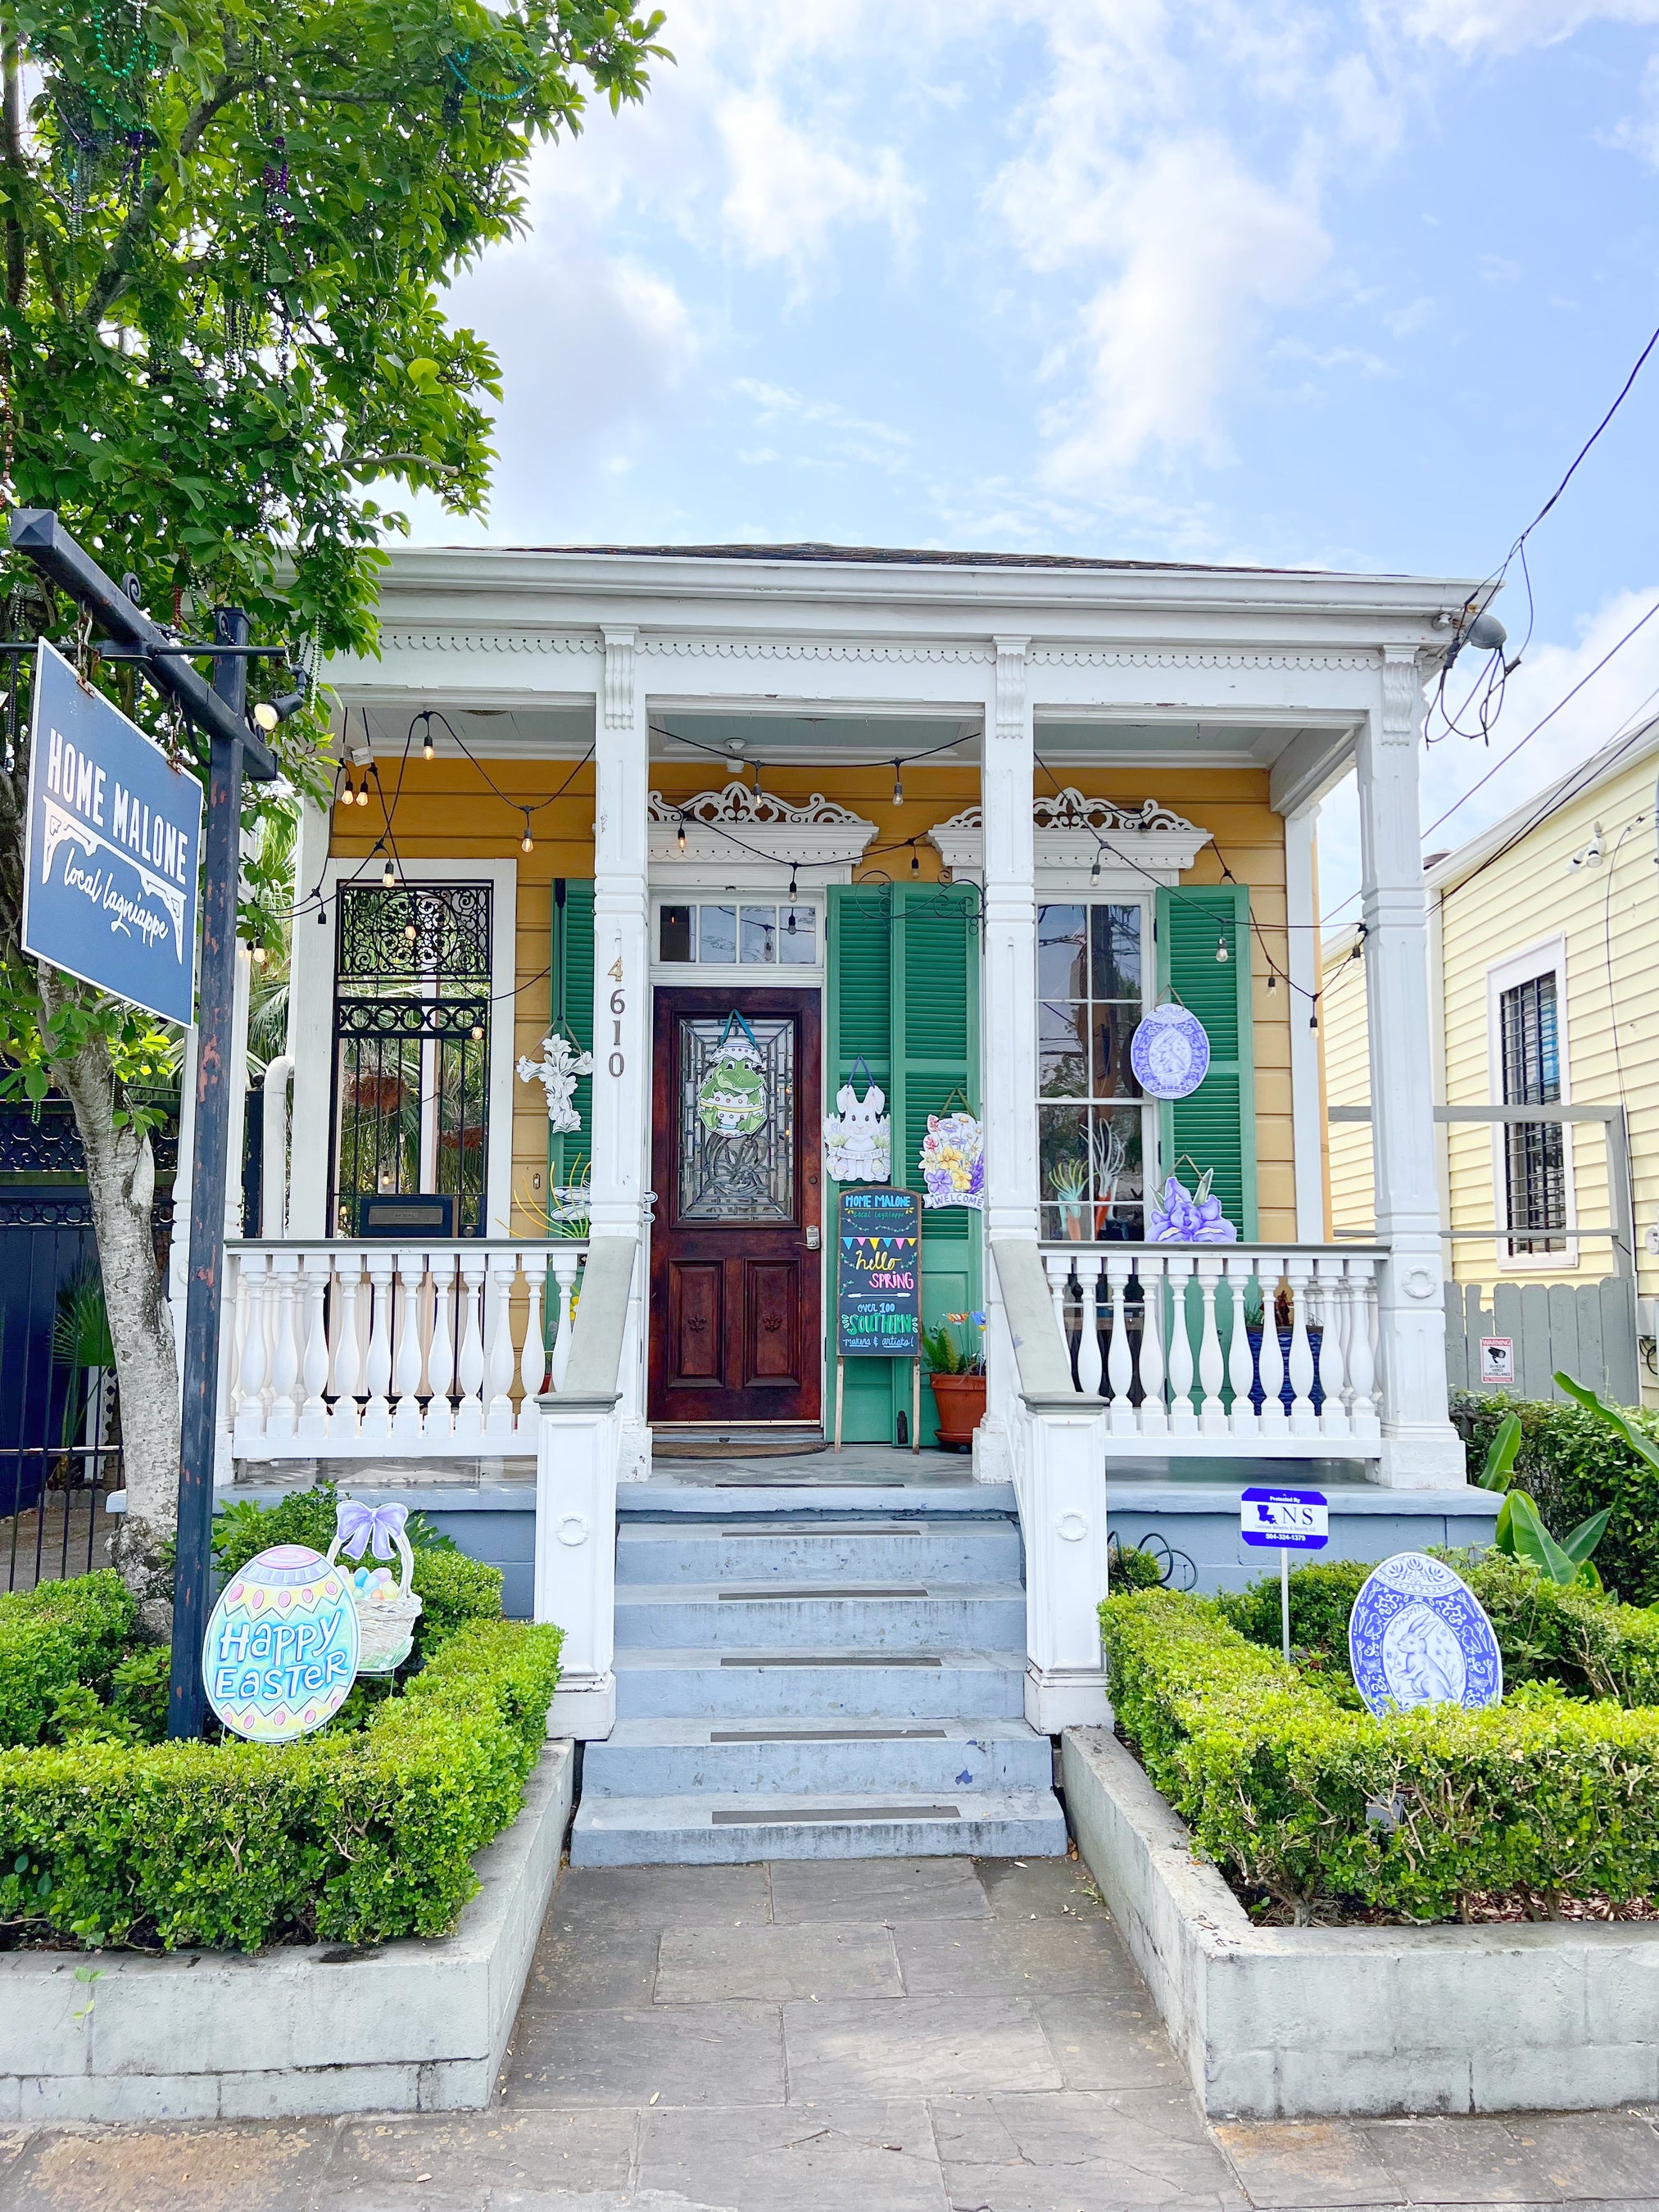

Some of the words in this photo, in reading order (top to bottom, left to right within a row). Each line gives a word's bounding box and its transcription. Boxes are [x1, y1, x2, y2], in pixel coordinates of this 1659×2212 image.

[48, 728, 107, 827] HOME
[112, 782, 188, 885] MALONE
[64, 847, 102, 904] local
[102, 873, 169, 948] lagniappe
[607, 955, 625, 1077] 4610
[859, 1149, 882, 1158] EASTER
[845, 1195, 872, 1208] HOME
[874, 1195, 910, 1208] MALONE
[935, 1194, 983, 1207] WELCOME
[855, 1250, 901, 1270] hello
[879, 1303, 895, 1313] 100
[846, 1313, 912, 1335] SOUTHERN
[843, 1338, 871, 1347] makers
[873, 1335, 879, 1347] &
[1265, 1533, 1306, 1541] 504-324-1379
[220, 1611, 342, 1667] Happy
